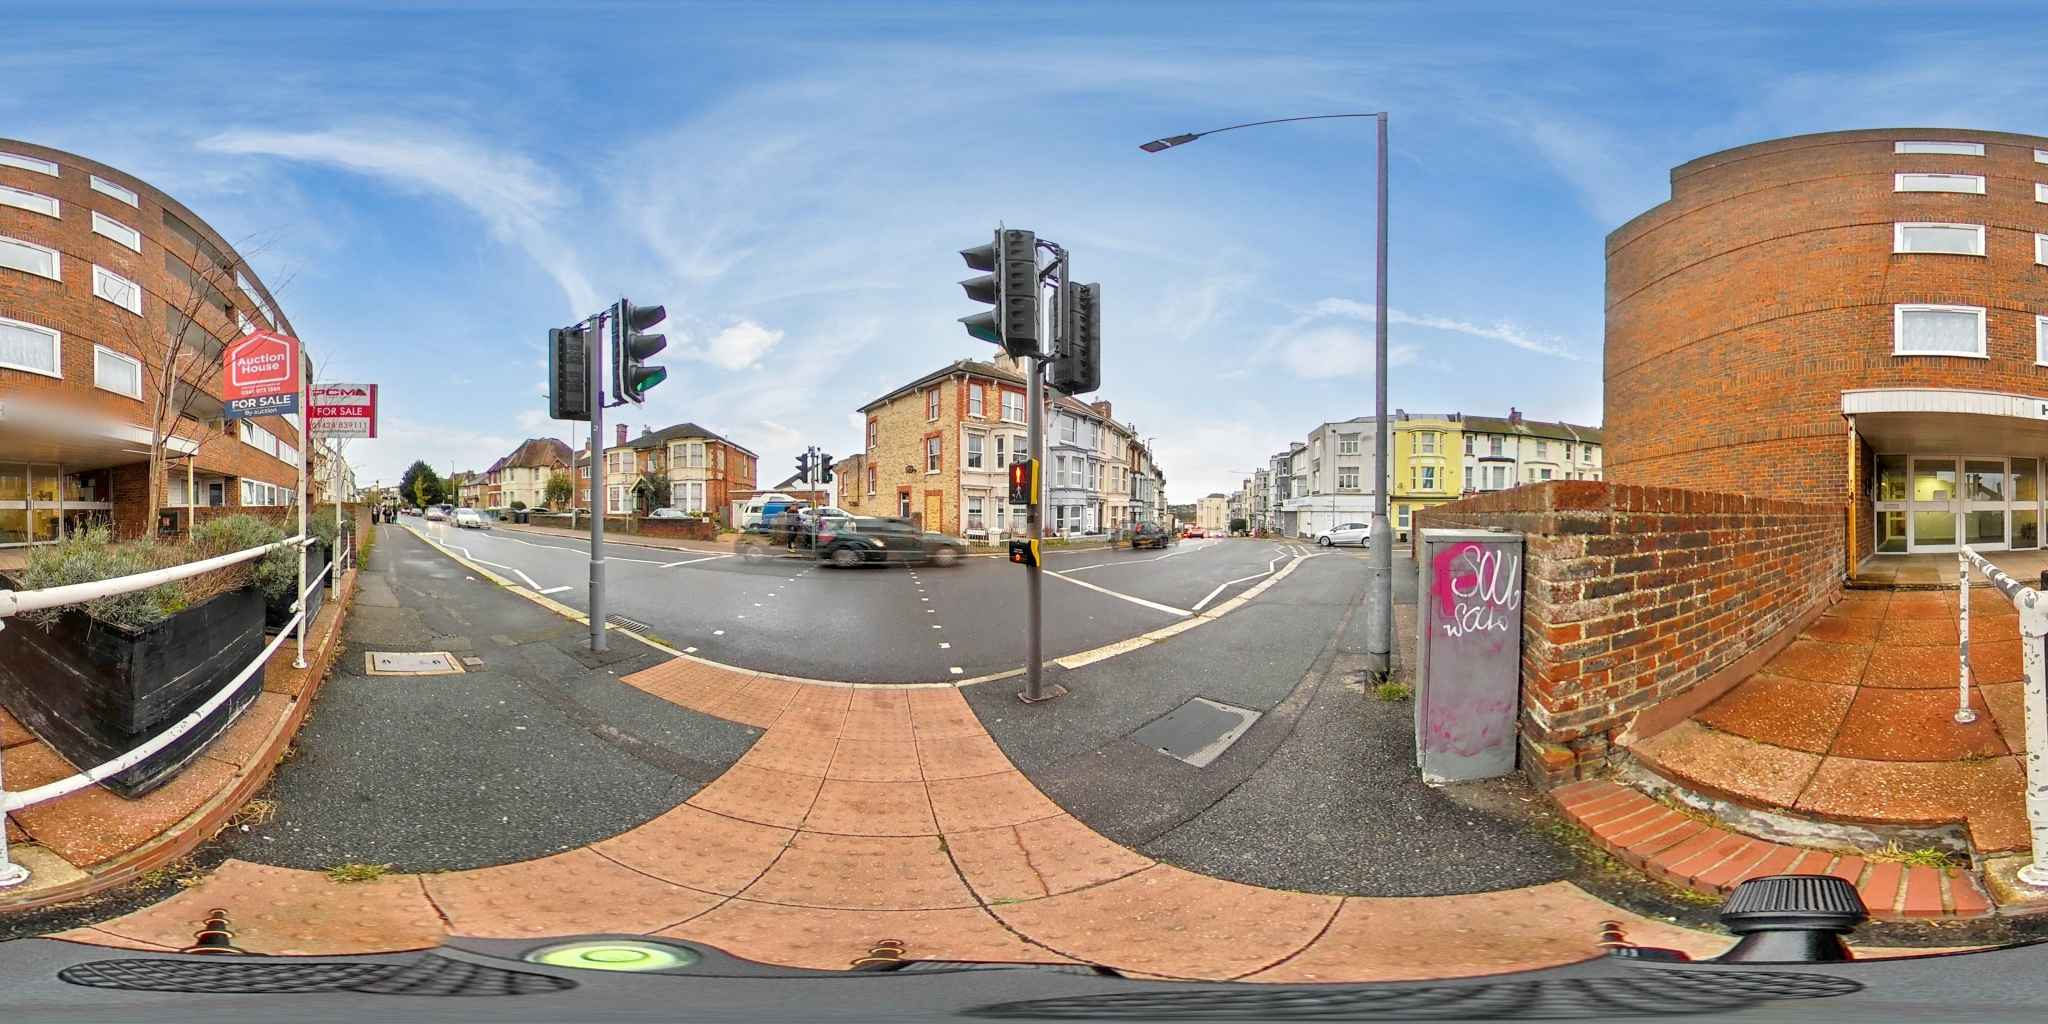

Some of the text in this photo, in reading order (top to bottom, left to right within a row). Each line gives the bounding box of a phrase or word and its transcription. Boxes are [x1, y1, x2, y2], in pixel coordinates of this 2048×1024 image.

[237, 353, 285, 367] Auction
[241, 362, 280, 374] House
[231, 394, 291, 409] FOR SALE
[317, 407, 363, 416] FOR SALE
